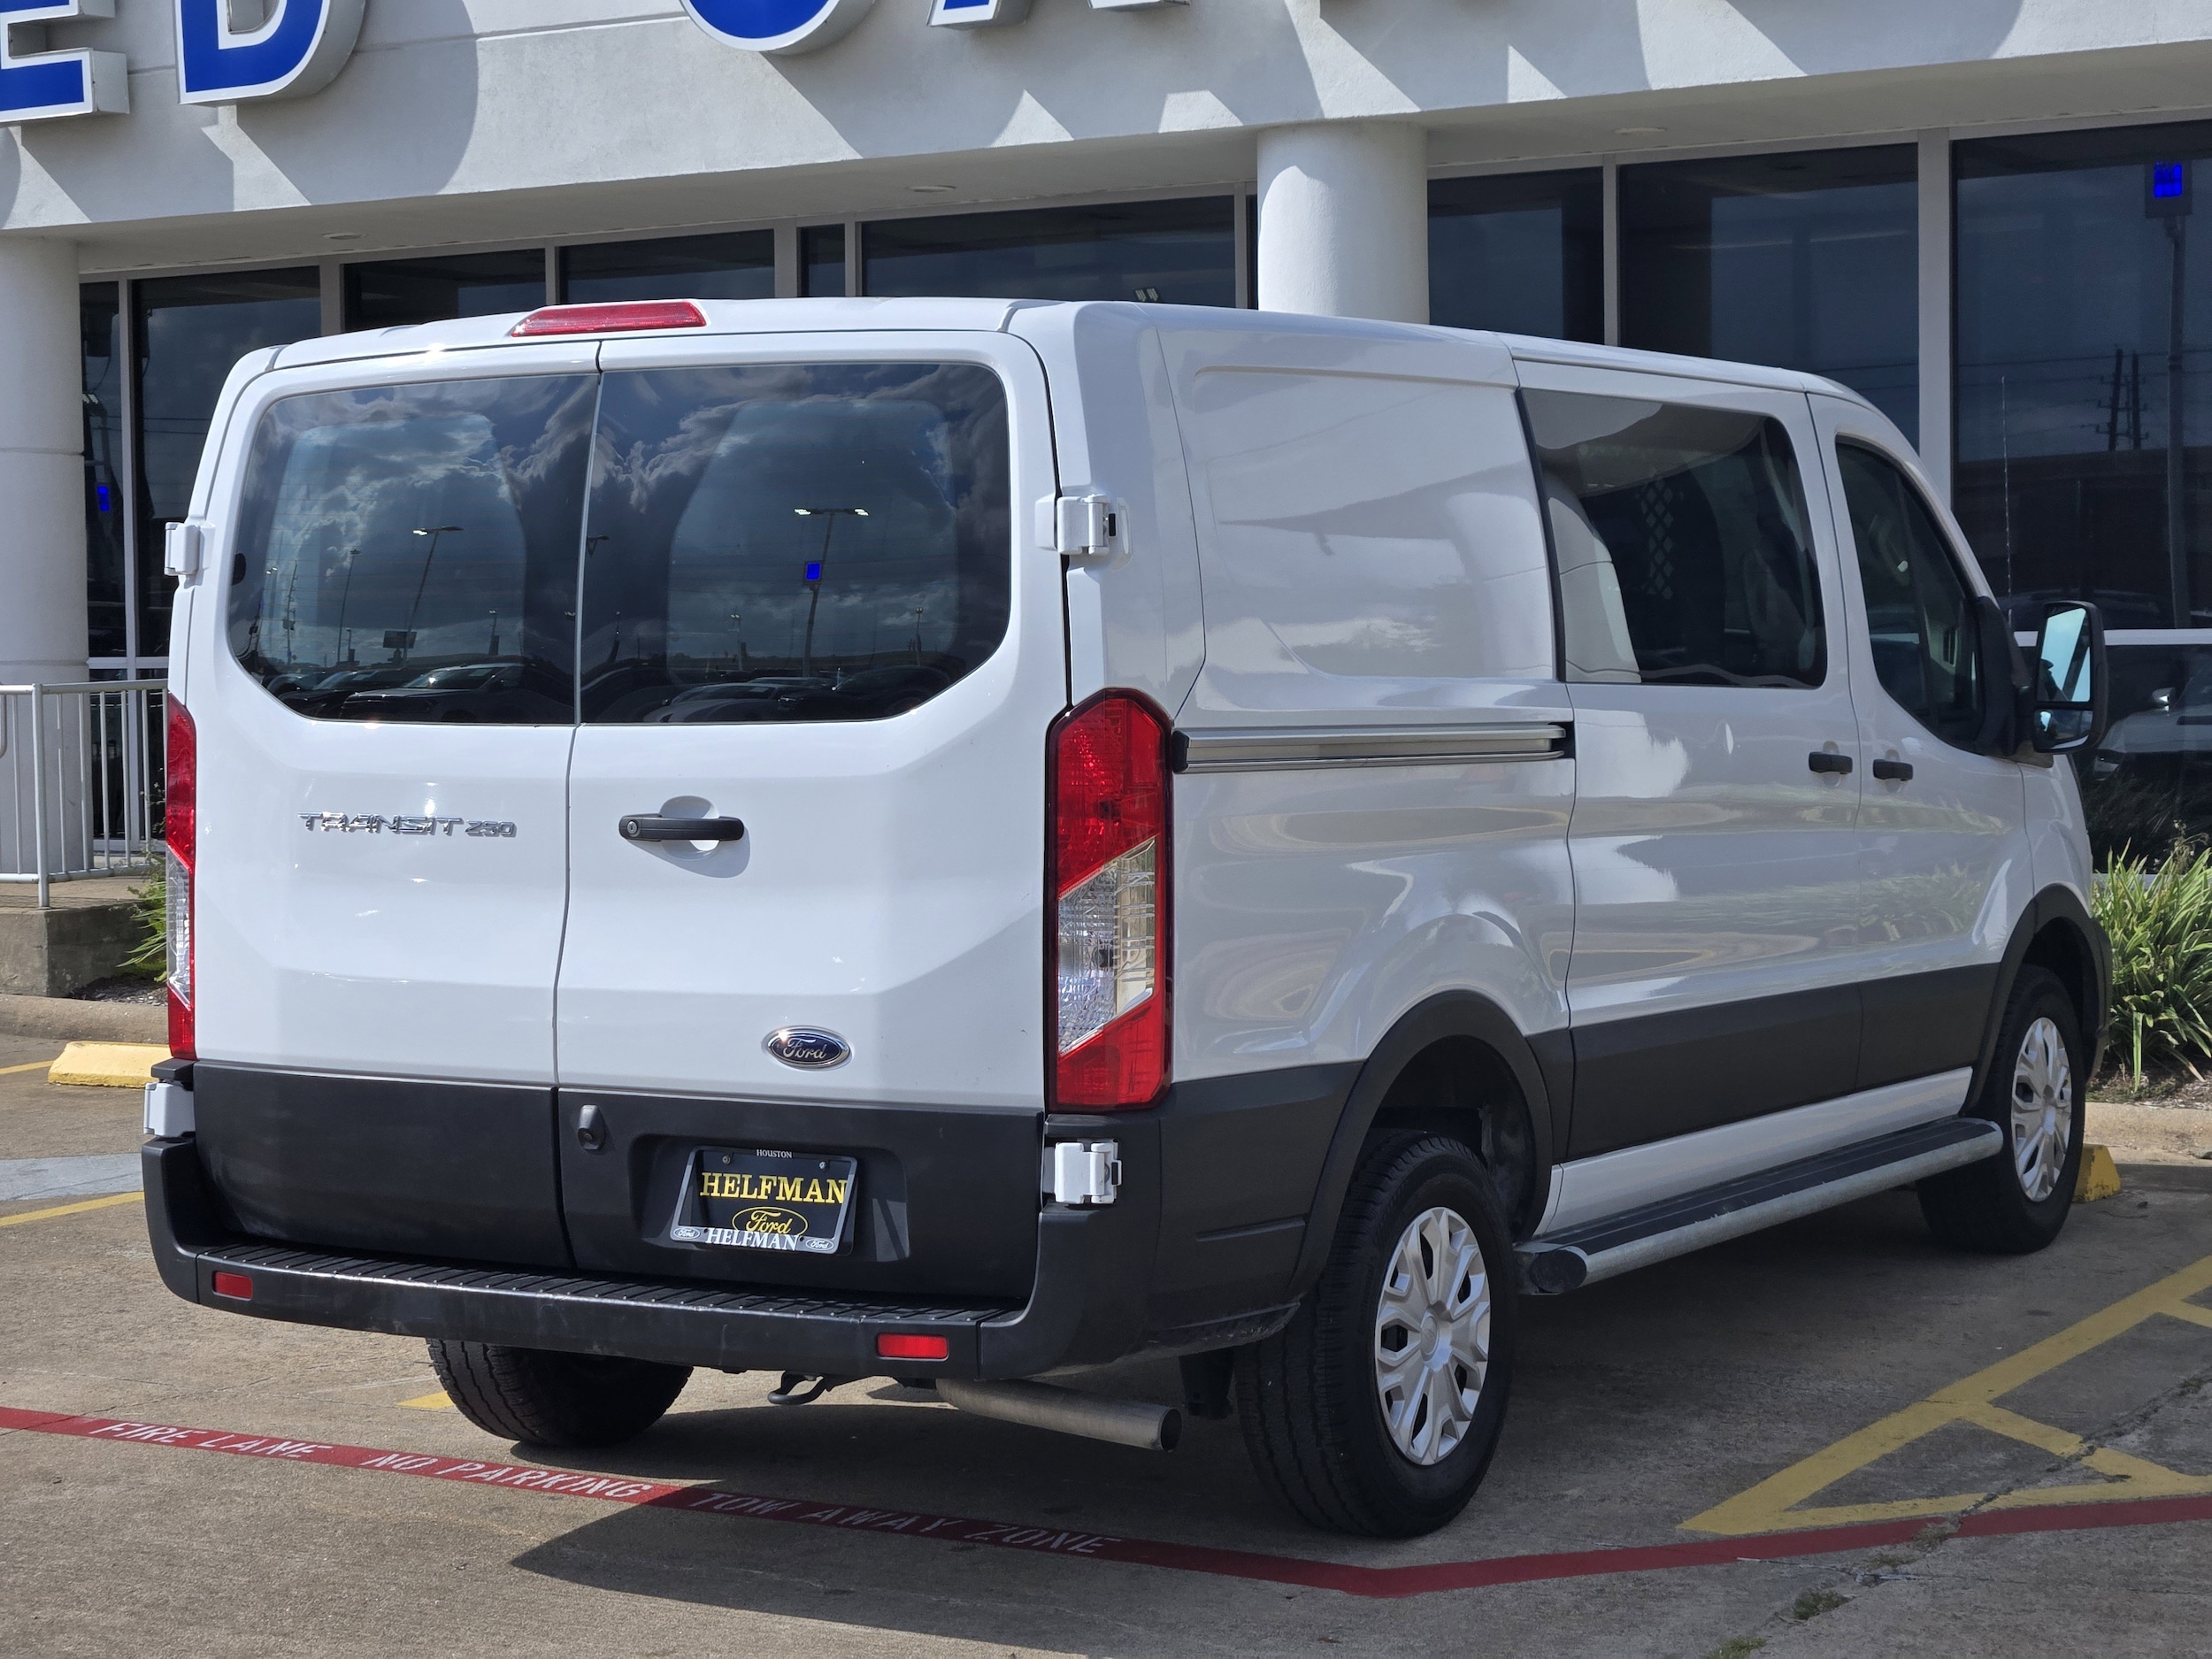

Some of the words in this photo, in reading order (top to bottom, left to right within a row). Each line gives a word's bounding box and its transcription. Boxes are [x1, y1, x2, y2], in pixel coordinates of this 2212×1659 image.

[297, 811, 464, 837] TRANSIT
[465, 820, 517, 837] 250
[782, 1037, 827, 1059] Ford
[756, 1148, 793, 1159] HOUSTON
[699, 1171, 848, 1204] HELFMAN
[745, 1209, 793, 1235] Ford
[705, 1227, 800, 1251] HELFMAN
[89, 1422, 208, 1444] FIRE
[196, 1434, 334, 1458] LANE
[360, 1453, 439, 1471] NO
[434, 1462, 654, 1497] PARKING
[688, 1493, 803, 1515] TOW
[797, 1507, 965, 1532] AWAY
[964, 1523, 1123, 1554] ZONE
